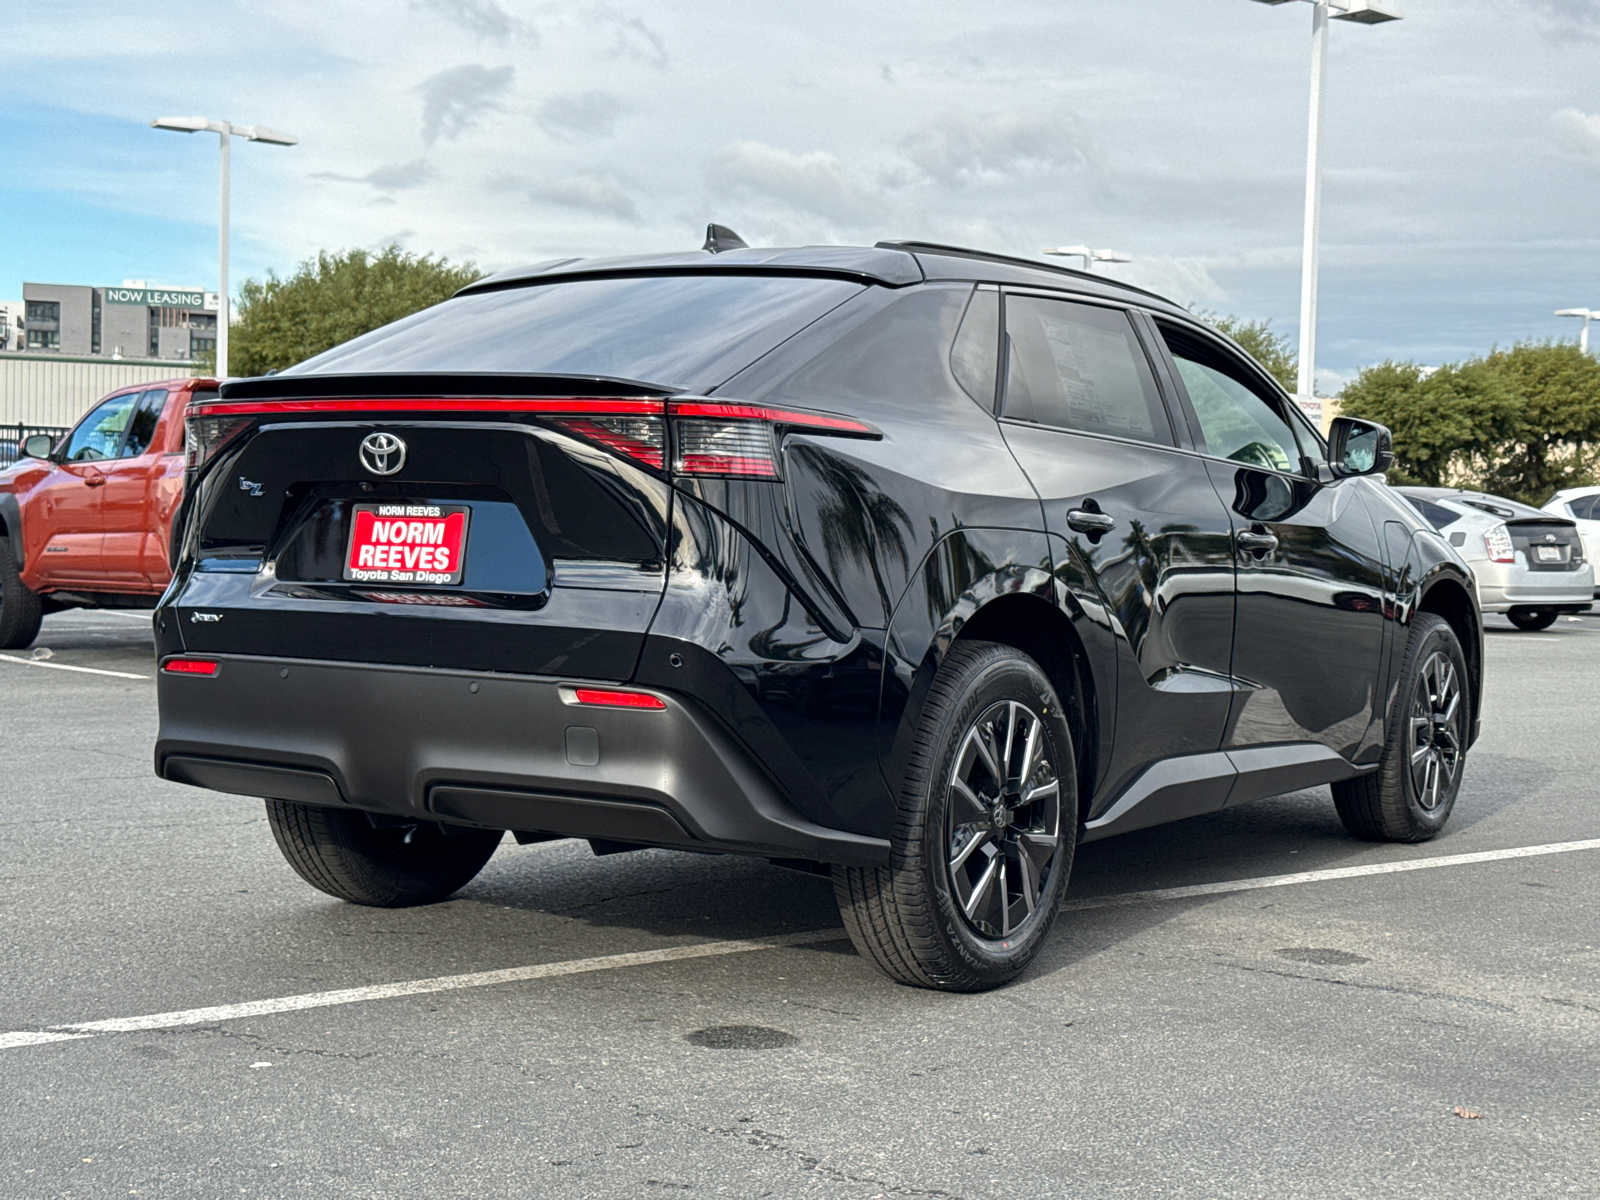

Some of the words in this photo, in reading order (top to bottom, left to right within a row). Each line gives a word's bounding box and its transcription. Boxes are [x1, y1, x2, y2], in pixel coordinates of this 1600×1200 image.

[108, 290, 143, 302] NOW
[147, 292, 202, 305] LEASING
[379, 506, 405, 516] NORM
[406, 507, 440, 517] REEVES
[371, 521, 446, 545] NORM
[358, 544, 450, 570] REEVES
[351, 568, 388, 581] Toyota
[390, 569, 415, 581] San
[416, 571, 452, 584] Diego
[946, 921, 993, 974] URANZA
